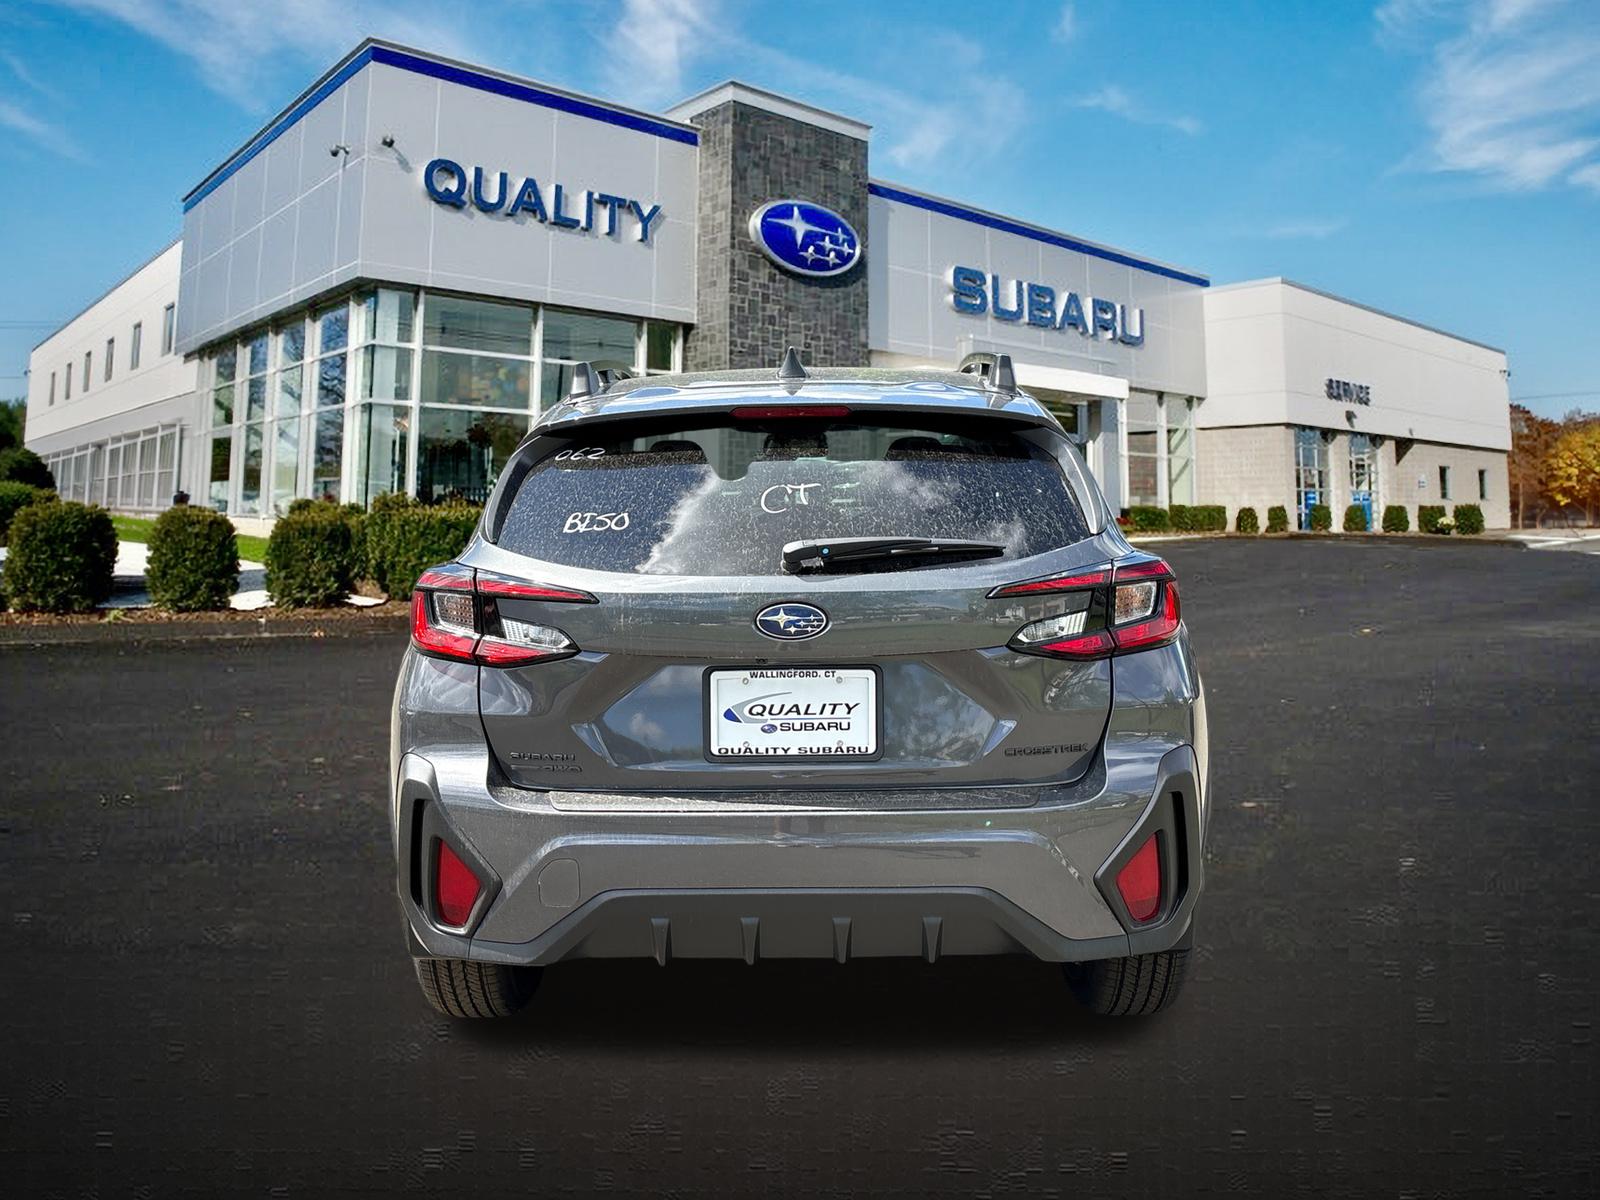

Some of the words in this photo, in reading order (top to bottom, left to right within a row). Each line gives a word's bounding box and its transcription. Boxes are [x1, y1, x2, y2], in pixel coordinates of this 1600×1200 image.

[424, 158, 661, 242] QUALITY
[950, 265, 1144, 346] SUBARU
[761, 483, 821, 513] CT
[824, 670, 836, 678] CT
[748, 702, 861, 717] QUALITY
[779, 721, 851, 732] SUBARU
[510, 752, 576, 761] SUBARU
[717, 746, 792, 755] QUALITY
[797, 746, 869, 754] SUBARU
[1004, 743, 1089, 757] CROSSTREK
